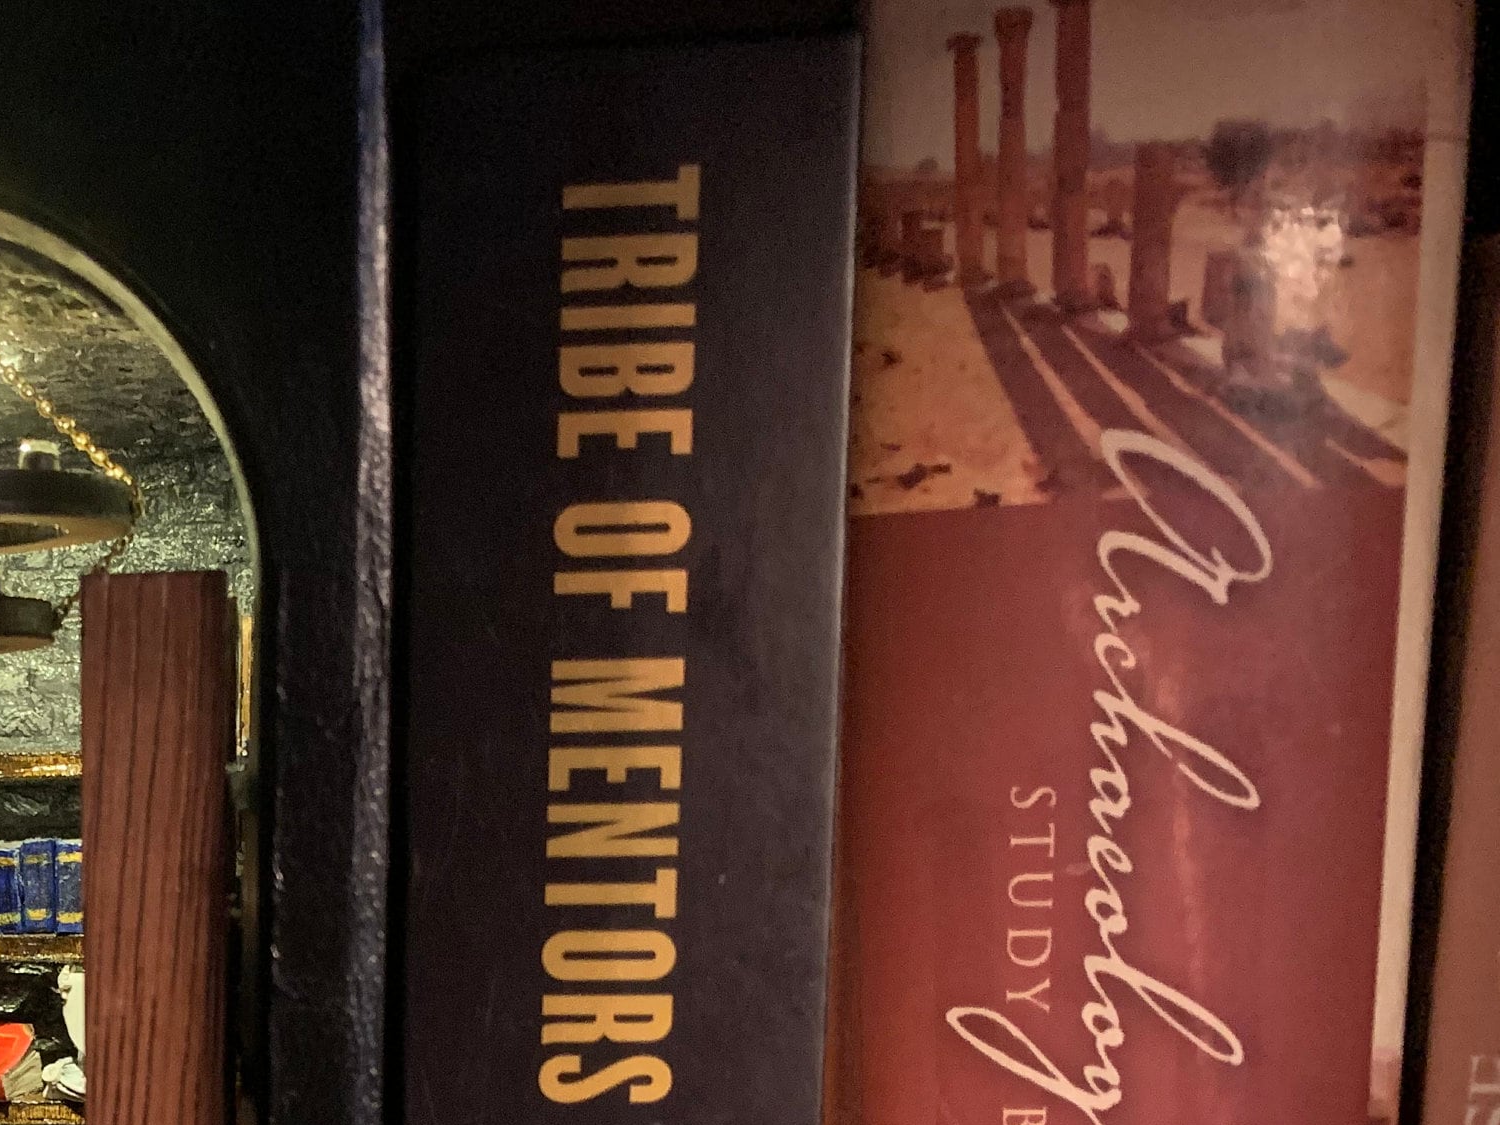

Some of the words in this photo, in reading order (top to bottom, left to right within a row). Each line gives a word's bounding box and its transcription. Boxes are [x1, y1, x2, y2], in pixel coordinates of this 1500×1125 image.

[557, 163, 701, 458] TRIBE
[553, 499, 692, 613] OF
[537, 657, 685, 1105] MENTORS
[1006, 785, 1056, 1012] STUDY
